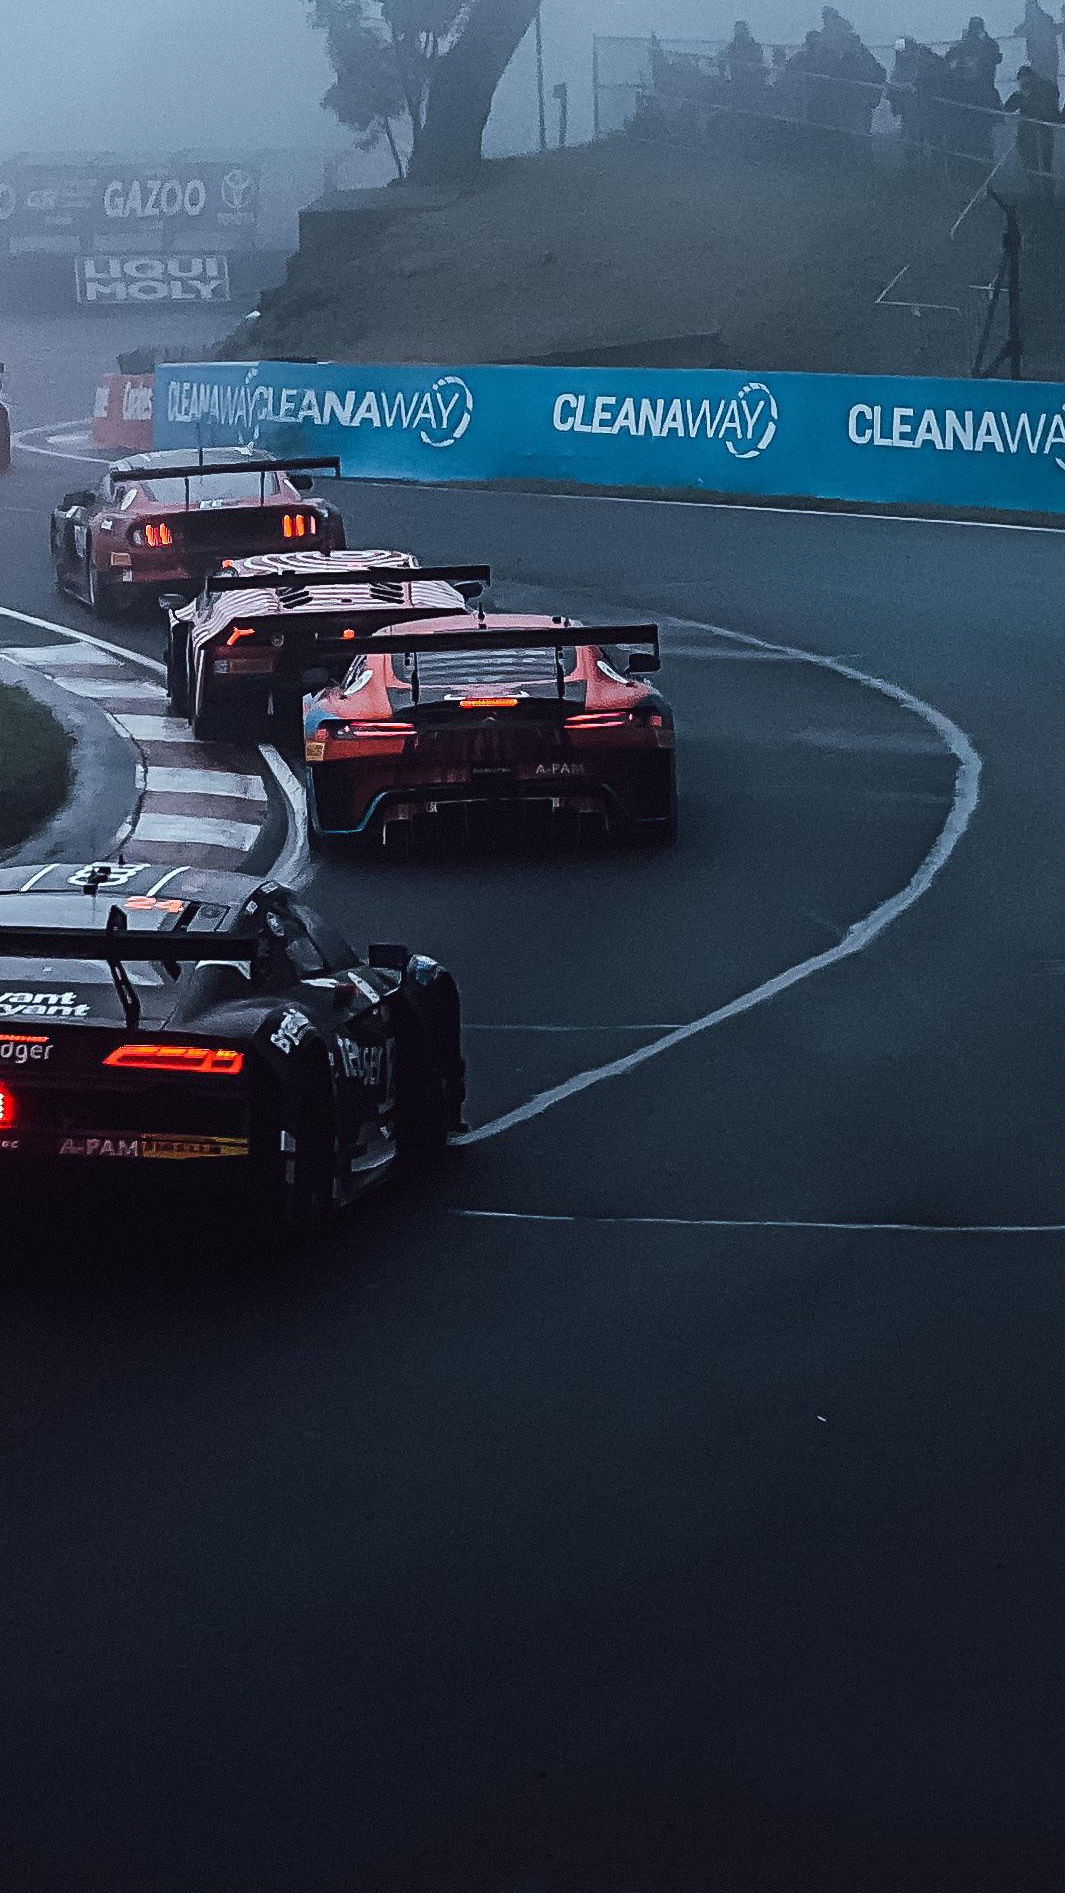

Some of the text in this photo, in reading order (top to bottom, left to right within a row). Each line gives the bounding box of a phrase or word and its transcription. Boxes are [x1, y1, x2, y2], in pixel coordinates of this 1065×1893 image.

[103, 180, 206, 218] GAZOO
[84, 258, 219, 278] LIQUI
[86, 280, 225, 301] MOLY
[256, 385, 459, 429] CLEANAWAY
[552, 393, 766, 440] CLEANAWAY
